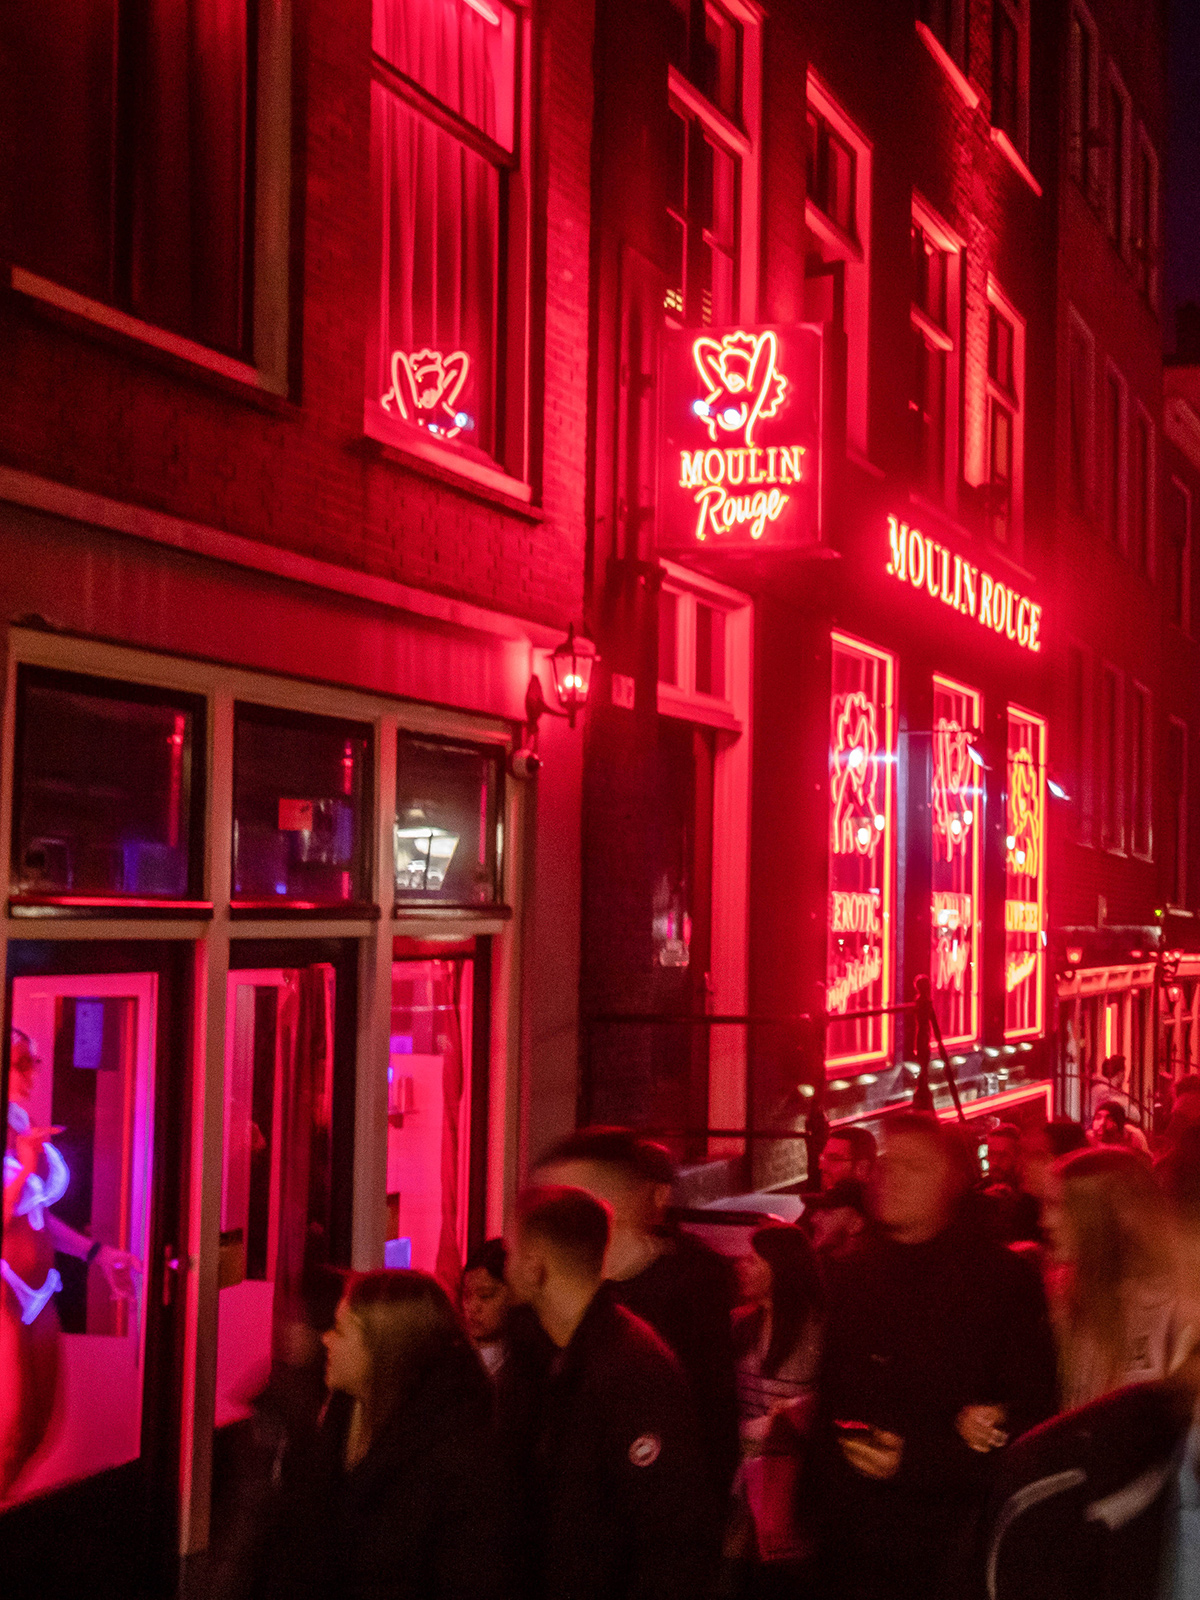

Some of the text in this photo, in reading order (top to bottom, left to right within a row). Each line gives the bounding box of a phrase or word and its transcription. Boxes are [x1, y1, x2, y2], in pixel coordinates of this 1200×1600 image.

[679, 446, 805, 488] MOULIN
[694, 486, 789, 540] Rouge
[887, 514, 1042, 652] MOULIN ROUGE
[831, 891, 881, 932] EROTIC
